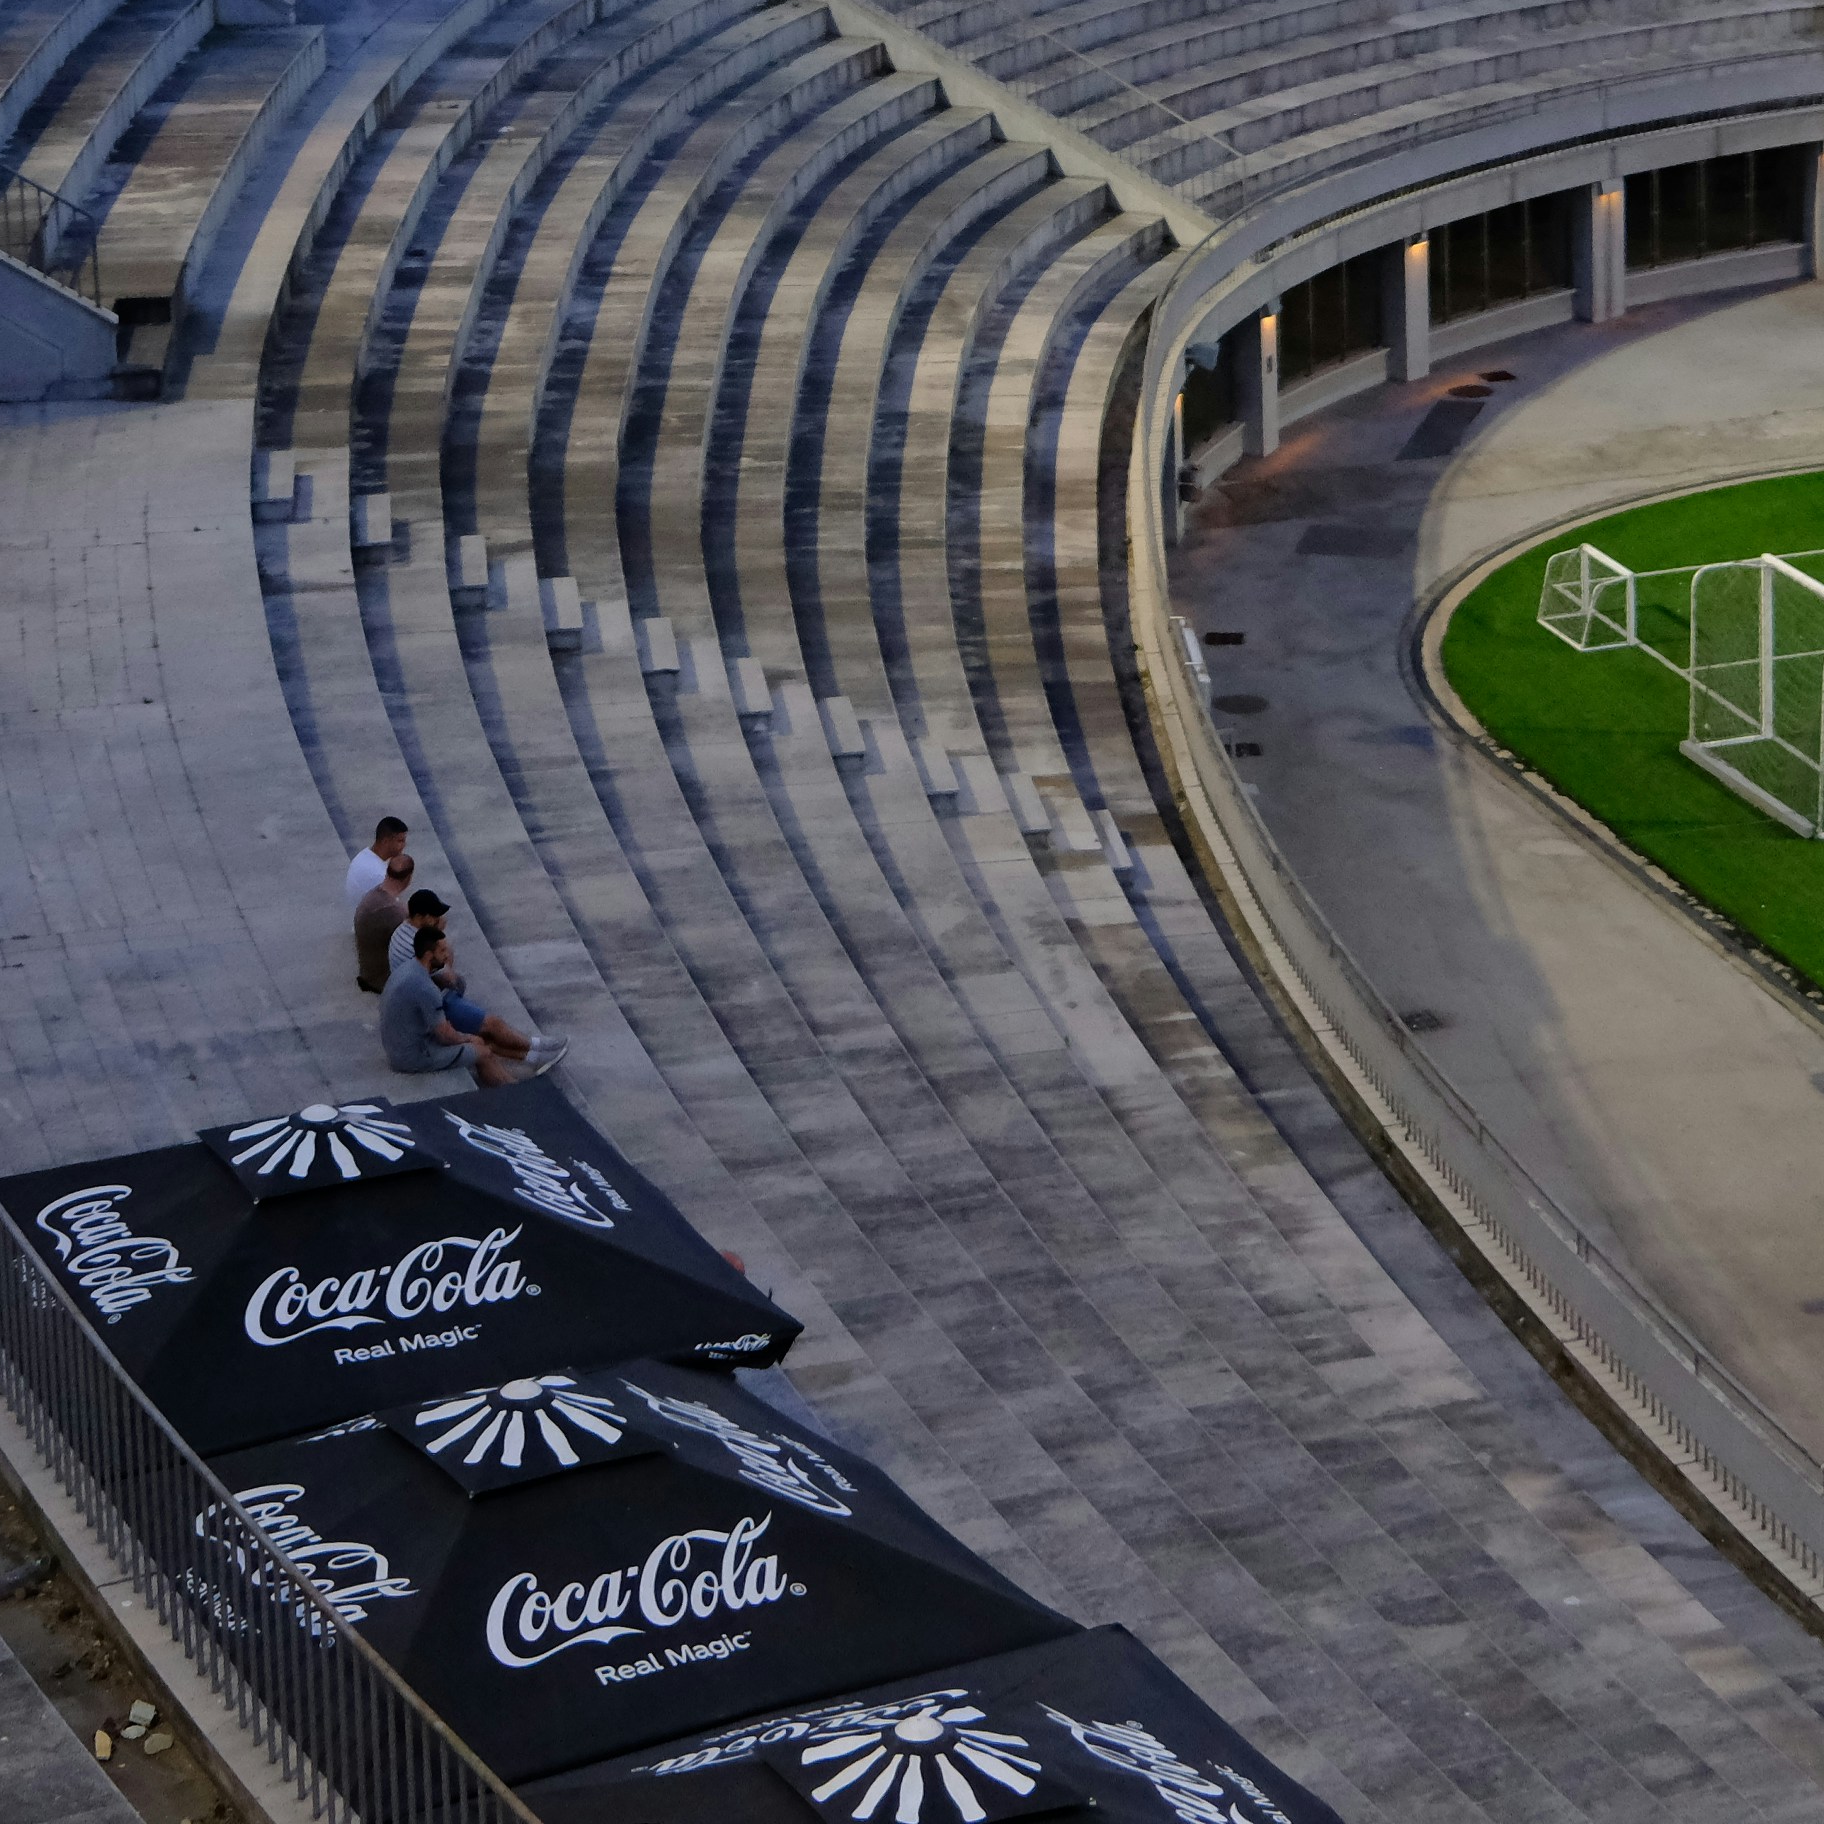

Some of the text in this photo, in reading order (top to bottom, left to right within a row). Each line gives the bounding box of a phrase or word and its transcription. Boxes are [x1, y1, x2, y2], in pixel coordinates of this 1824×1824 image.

[36, 1184, 198, 1314] Coca-Cola
[244, 1223, 527, 1347] Coca-Cola
[333, 1325, 480, 1365] Real Magic
[486, 1509, 788, 1668] Coca-Cola
[594, 1634, 752, 1686] Real Magic
